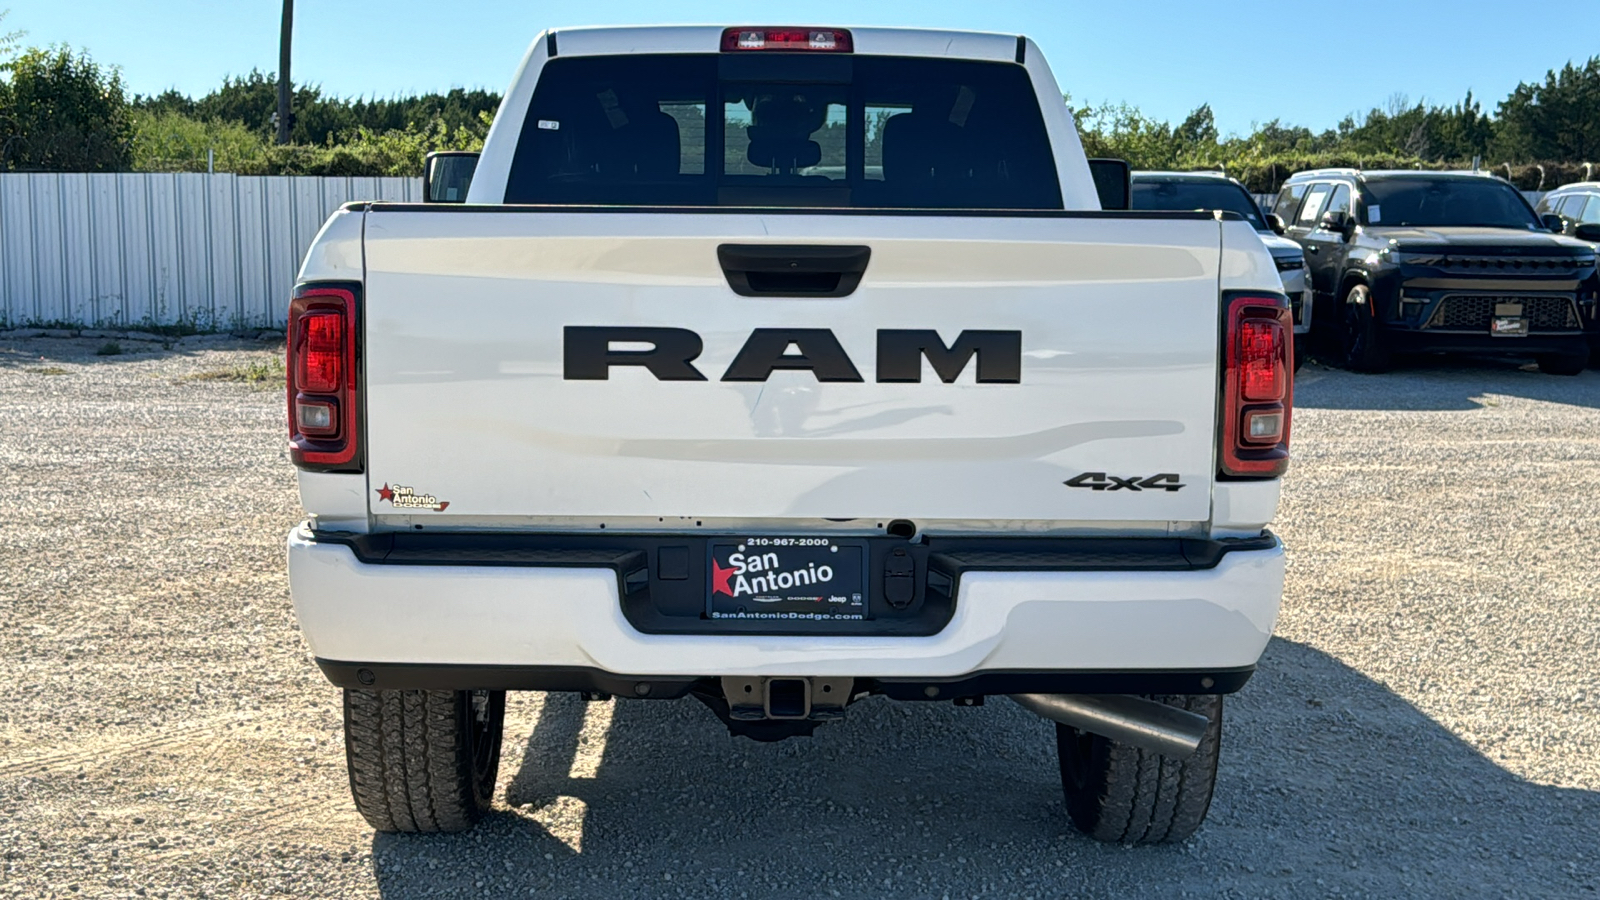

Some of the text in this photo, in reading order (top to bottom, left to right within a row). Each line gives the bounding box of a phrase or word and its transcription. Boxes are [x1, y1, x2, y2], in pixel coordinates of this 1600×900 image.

[563, 325, 1022, 384] RAM
[1062, 471, 1187, 492] 4x4
[393, 485, 413, 494] San
[393, 494, 435, 503] Antonio
[747, 538, 829, 546] 210-967-2000
[728, 552, 779, 575] San
[733, 563, 834, 598] Antonio
[828, 595, 847, 604] Jeep
[712, 612, 863, 621] SanAntonioDodge.com
